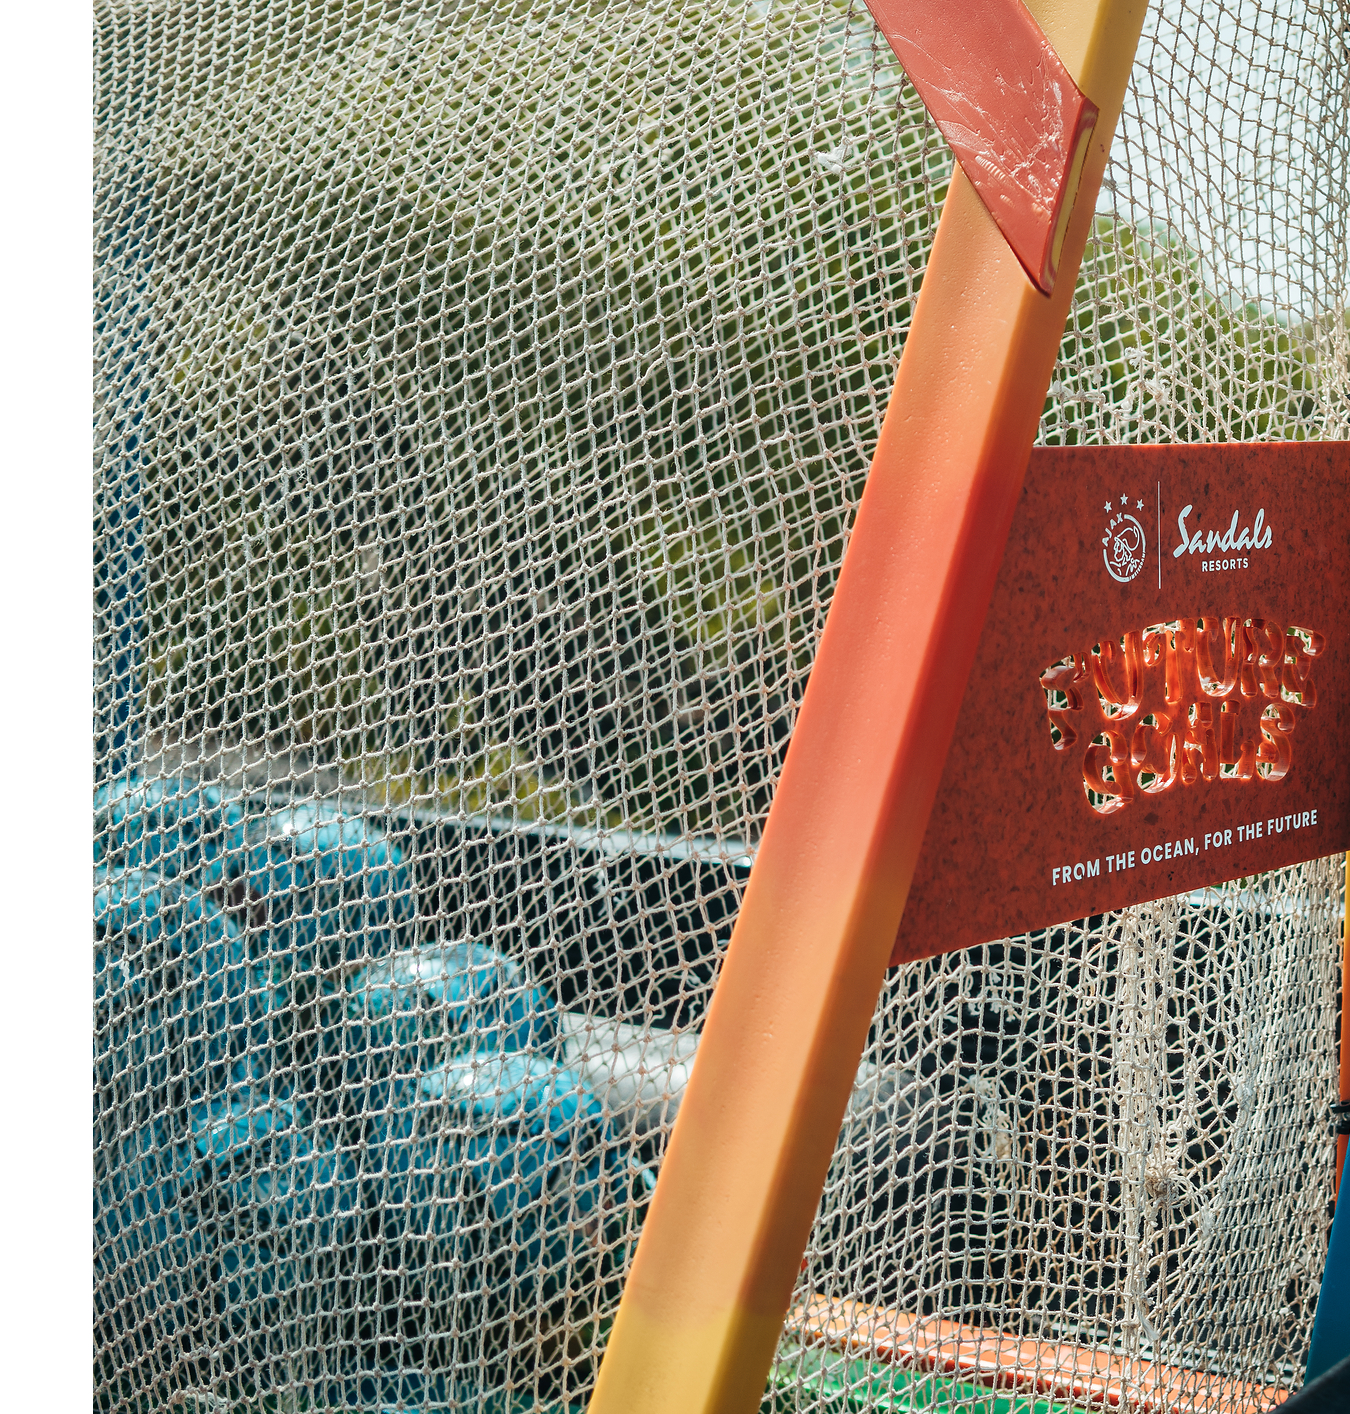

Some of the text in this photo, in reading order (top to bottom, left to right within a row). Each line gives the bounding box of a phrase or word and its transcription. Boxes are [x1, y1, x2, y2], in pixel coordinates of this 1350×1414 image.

[1102, 512, 1124, 547] AJAX
[1173, 504, 1273, 558] Sandals
[1201, 557, 1250, 573] RESORTS
[1039, 616, 1327, 751] FUTURE
[1082, 699, 1297, 815] GOALS
[1052, 809, 1318, 886] FROM THE OCEAN, FOR THE FUTURE
